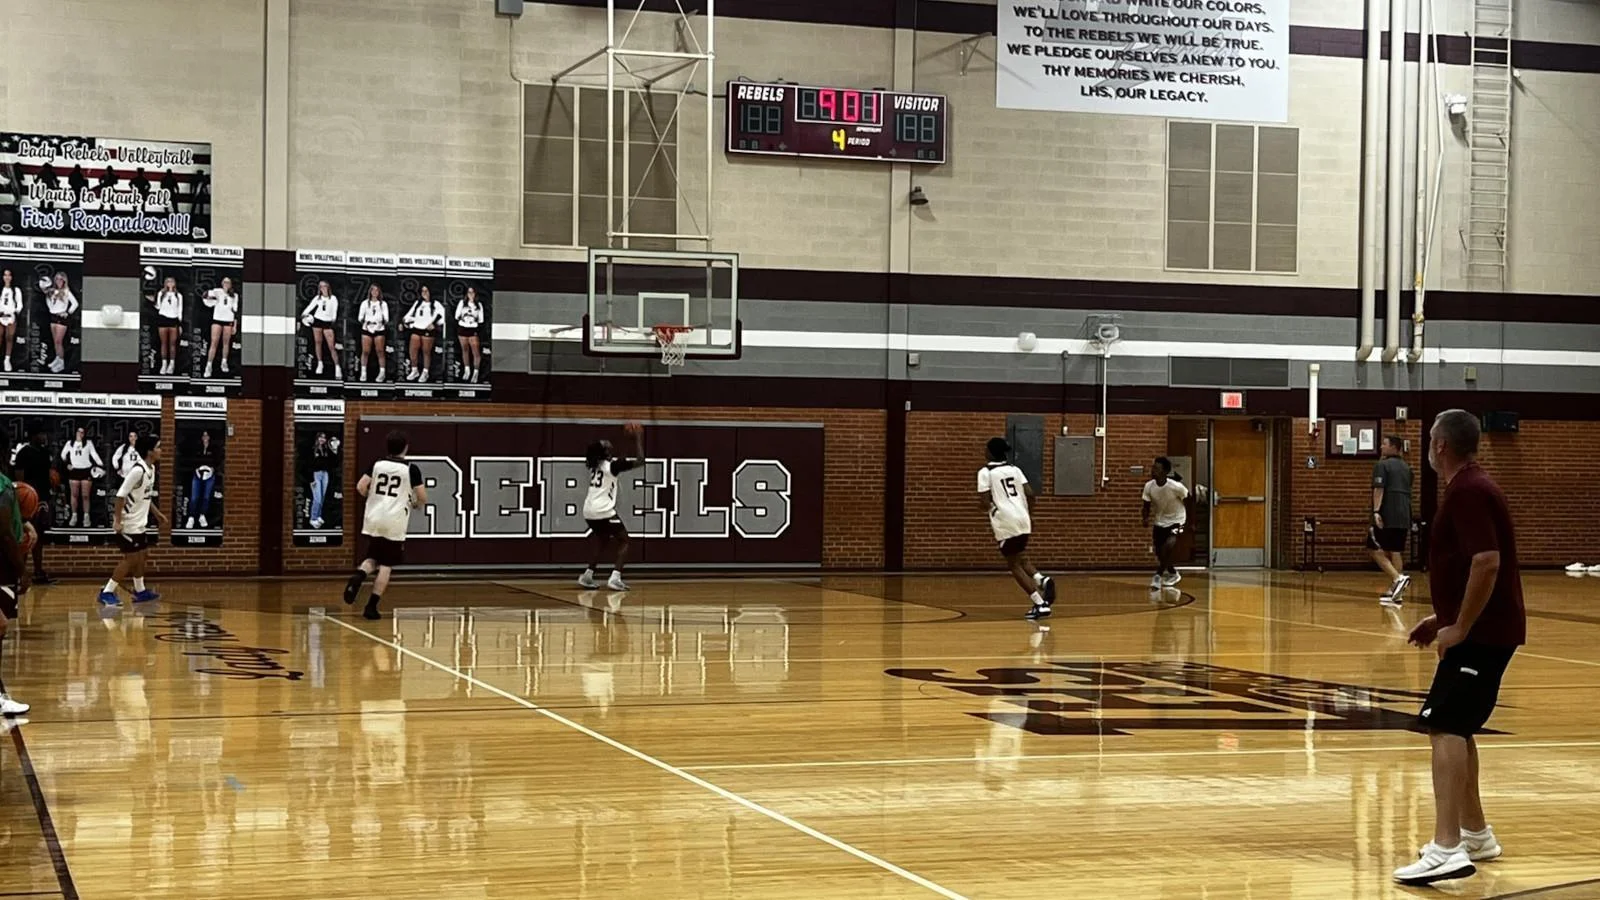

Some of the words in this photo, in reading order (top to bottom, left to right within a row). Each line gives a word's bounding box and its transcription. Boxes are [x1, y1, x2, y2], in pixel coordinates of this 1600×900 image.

[1173, 0, 1203, 10] OUR
[1013, 5, 1059, 20] WE'LL
[1061, 9, 1098, 21] LOVE
[1101, 11, 1200, 28] THROUGHOUT
[1202, 18, 1232, 31] OUR
[1024, 25, 1044, 38] TO
[1046, 27, 1075, 40] THE
[1078, 29, 1134, 43] REBELS
[1137, 32, 1161, 45] WE
[1164, 34, 1199, 47] WILL
[1201, 37, 1221, 49] BE
[1007, 43, 1032, 56] WE
[1034, 45, 1092, 60] PLEDGE
[1095, 49, 1178, 64] OURSELVES
[1181, 53, 1224, 67] ANEW
[1226, 57, 1245, 68] TO
[1042, 64, 1071, 77] THY
[1074, 66, 1150, 82] MEMORIES
[1153, 70, 1176, 83] WE
[737, 85, 785, 102] REBELS
[1115, 87, 1147, 100] OUR
[894, 96, 940, 112] VISITOR
[832, 129, 845, 150] 4
[847, 136, 871, 147] PERIOD
[18, 139, 57, 163] Lady
[61, 142, 111, 162] Rebels
[117, 145, 194, 168] Volleyball
[28, 183, 76, 204] Wants
[80, 187, 96, 203] to
[100, 187, 143, 207] thank
[148, 190, 172, 207] all
[20, 205, 64, 230] First
[68, 207, 191, 236] Responders!!!
[5, 395, 20, 403] REBEL
[21, 396, 53, 404] VOLLEYBALL
[75, 397, 107, 405] VOLLEYBALL
[111, 398, 127, 406] REBEL
[128, 399, 160, 407] VOLLEYBALL
[178, 400, 193, 408] REBEL
[194, 401, 224, 409] VOLLEYBALL
[313, 404, 342, 412] VOLLEYBALL
[375, 473, 401, 498] 22
[1000, 477, 1018, 499] 15
[402, 456, 792, 539] REBELS
